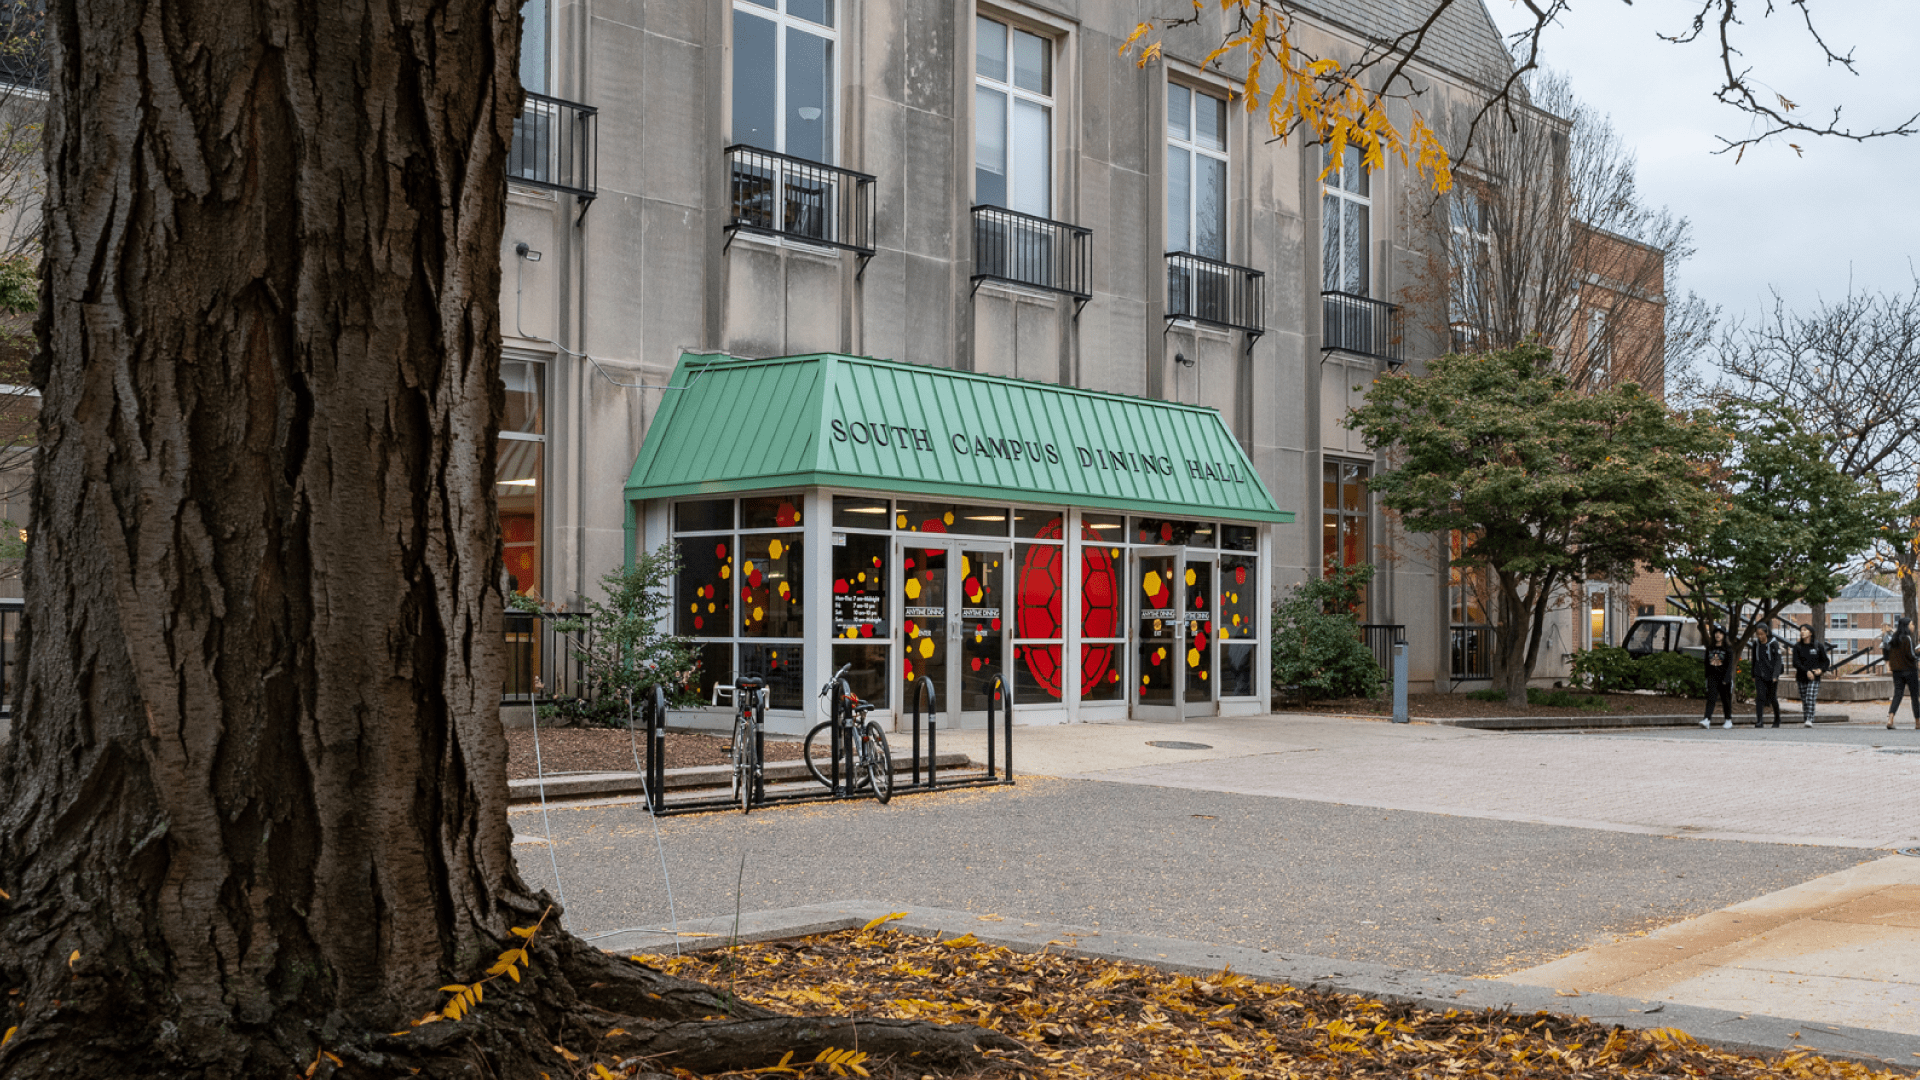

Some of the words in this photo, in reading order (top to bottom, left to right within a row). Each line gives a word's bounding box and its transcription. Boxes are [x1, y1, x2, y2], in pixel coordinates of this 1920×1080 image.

[831, 419, 933, 452] SOUTH
[952, 433, 1059, 465] CAMPUS
[1077, 446, 1173, 476] DINING
[1186, 459, 1244, 483] HALL
[905, 608, 926, 616] ANYTIME
[927, 608, 944, 616] DINING
